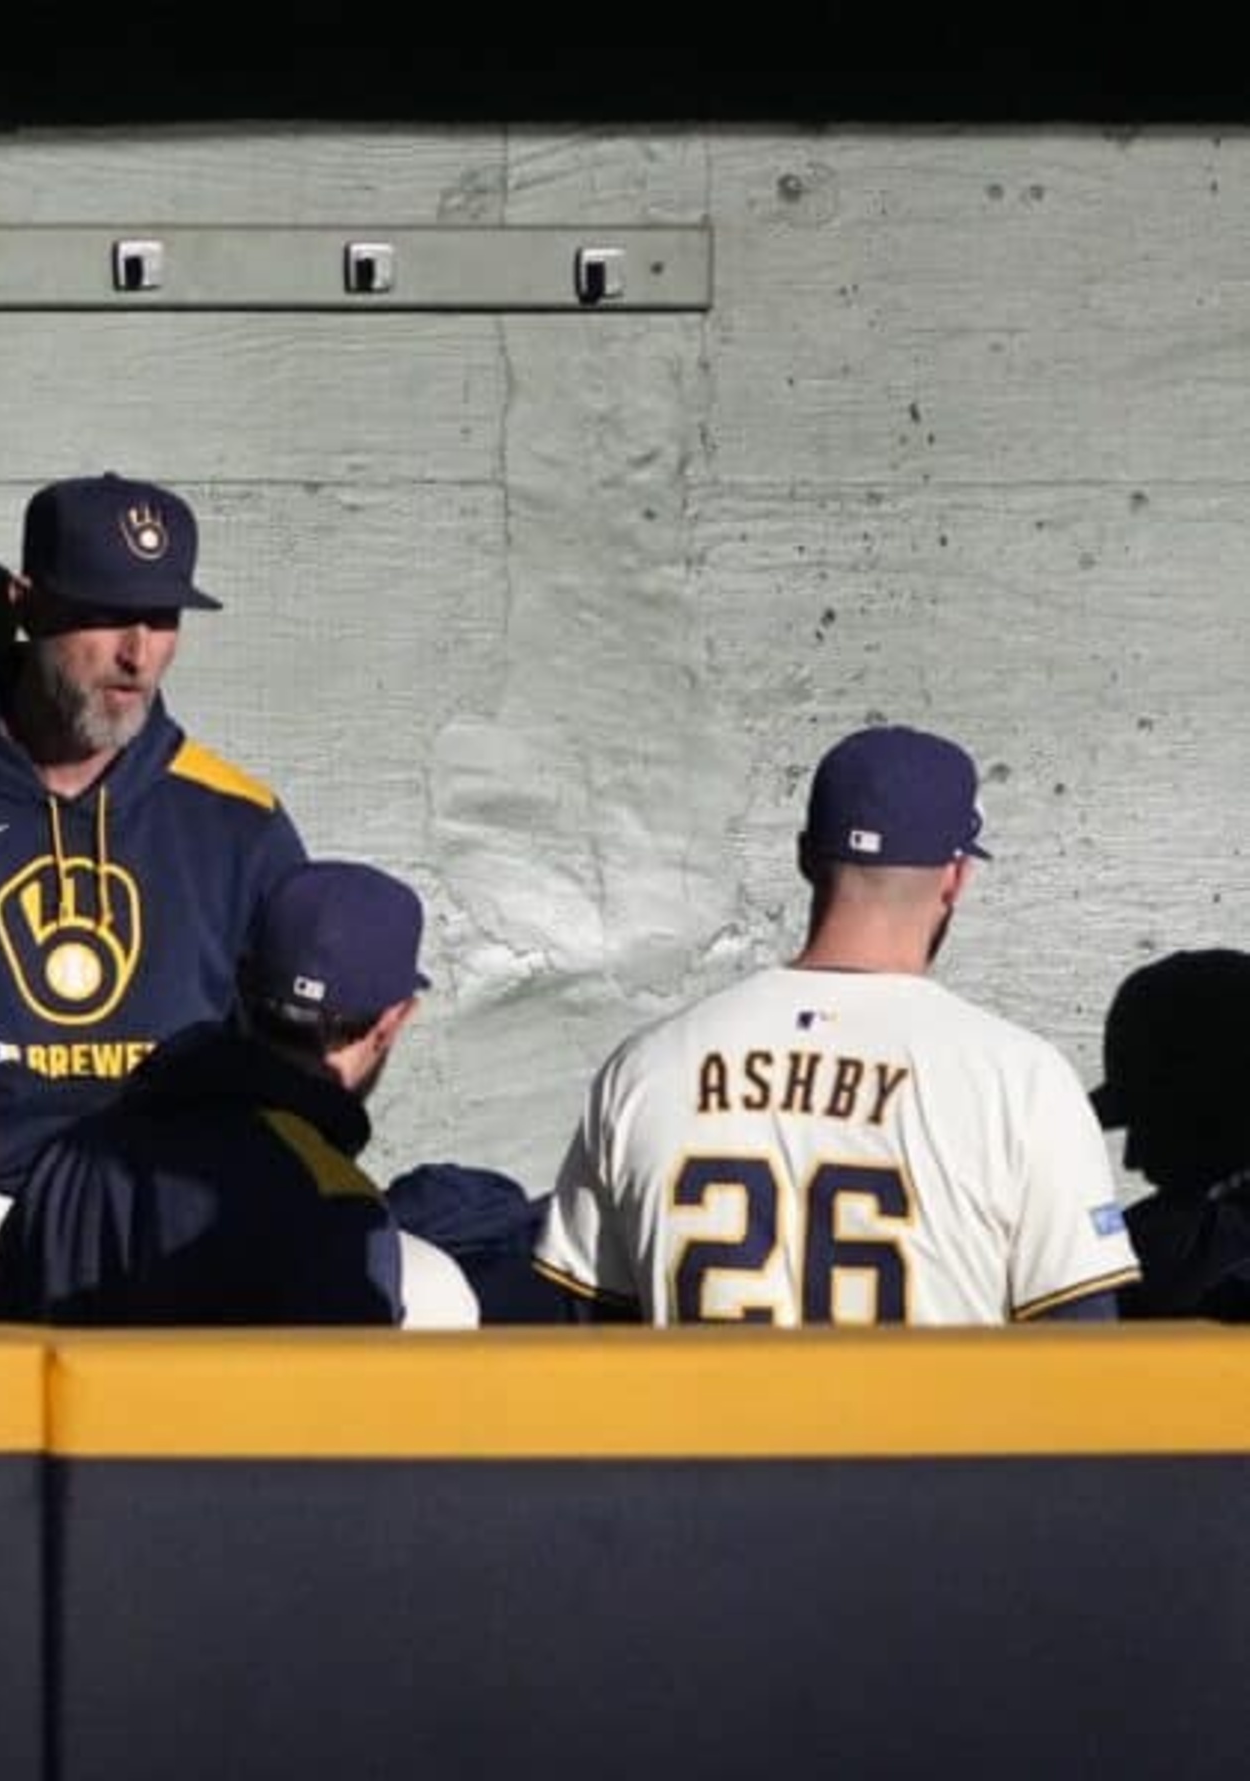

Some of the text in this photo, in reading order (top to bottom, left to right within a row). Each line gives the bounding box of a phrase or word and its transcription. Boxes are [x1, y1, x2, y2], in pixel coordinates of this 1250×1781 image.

[26, 1042, 157, 1078] BREWE
[696, 1051, 909, 1126] ASHBY
[669, 1150, 915, 1324] 26
